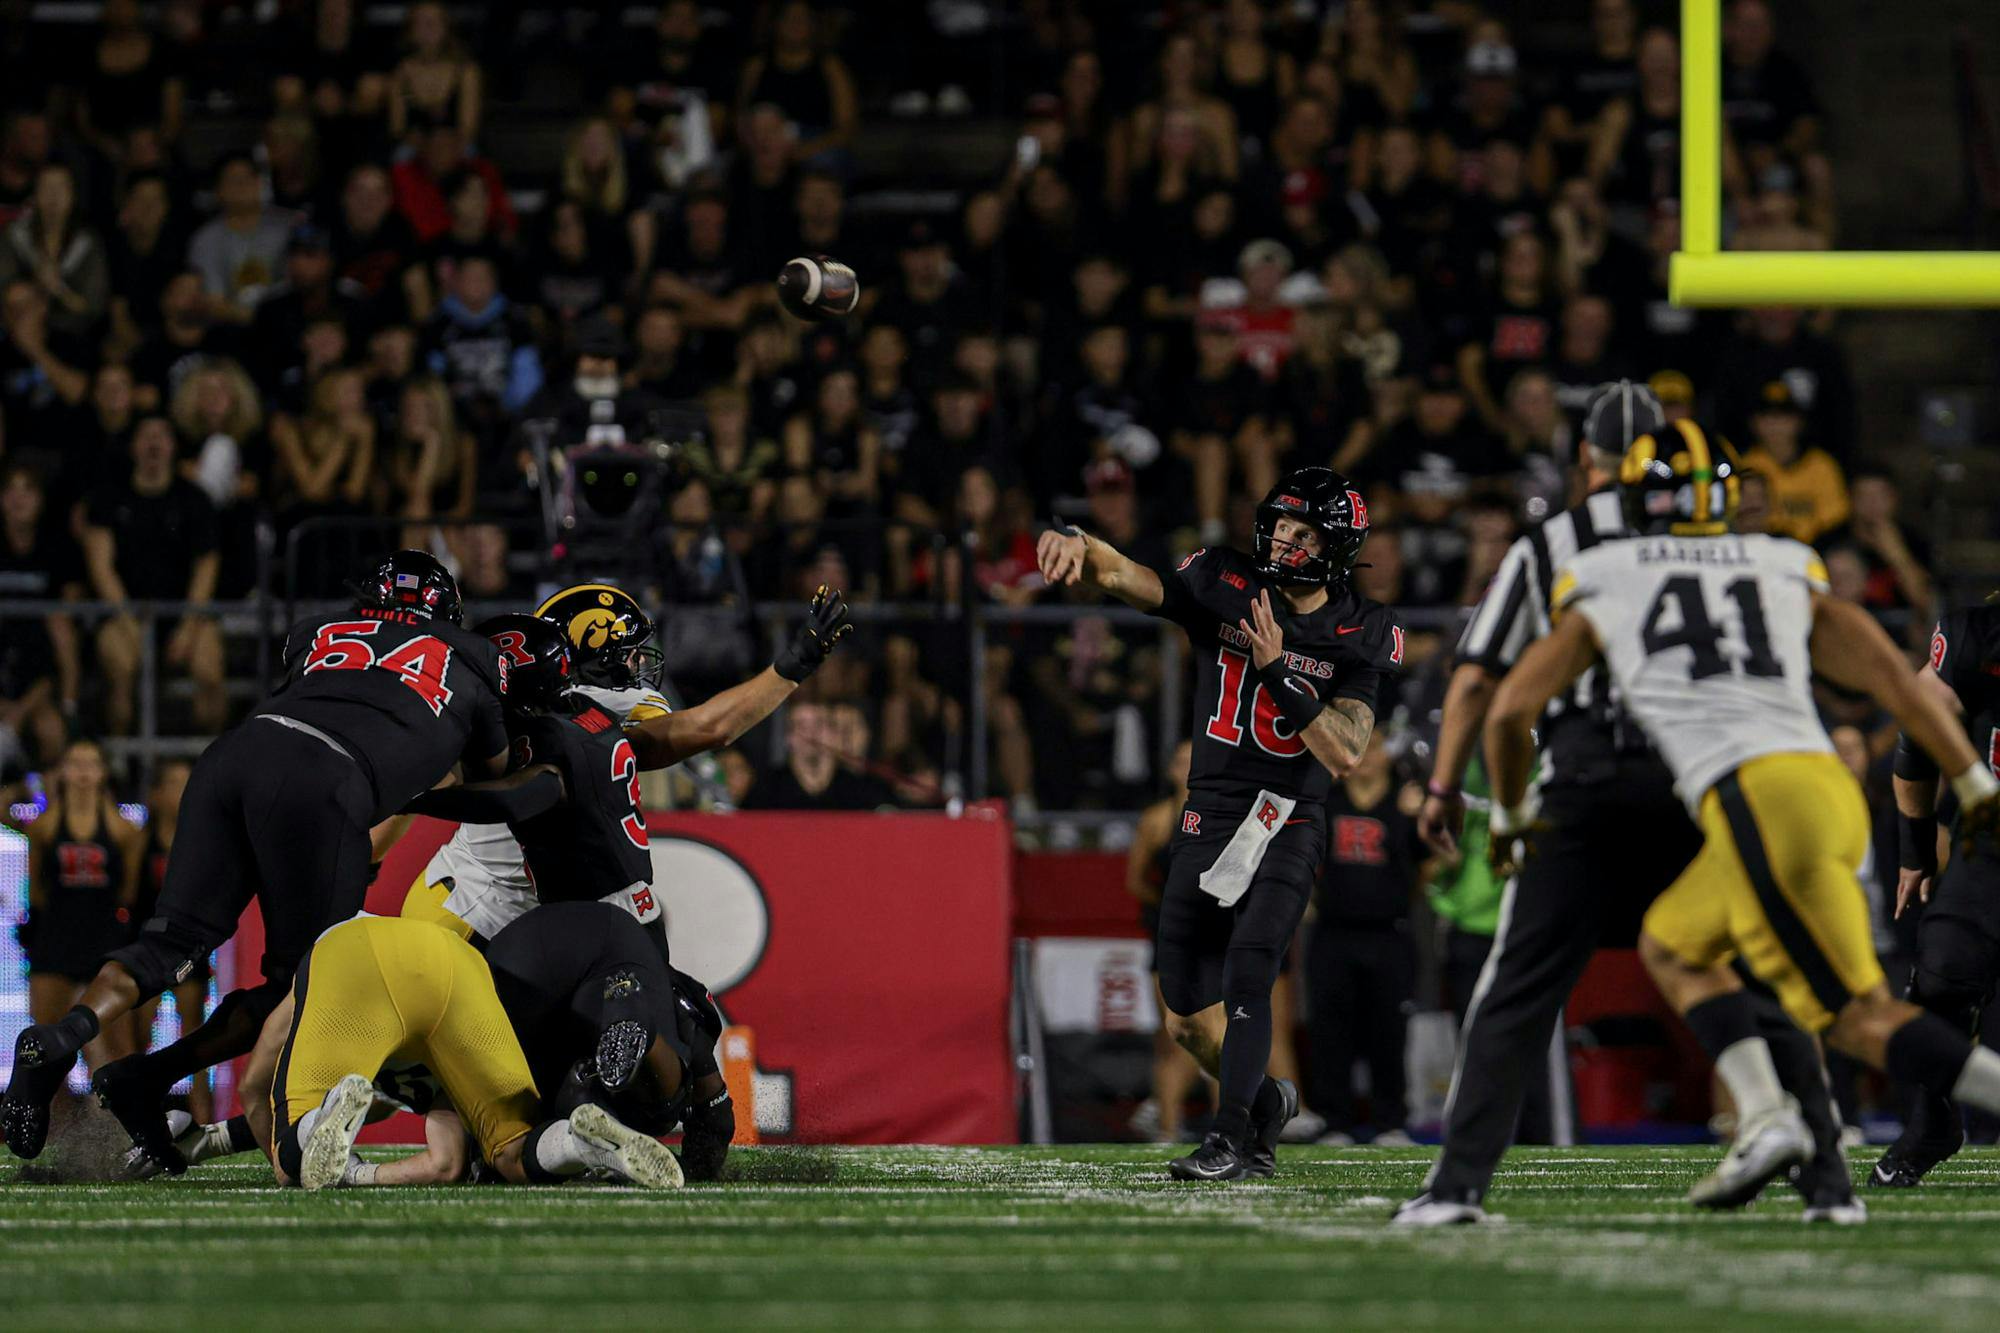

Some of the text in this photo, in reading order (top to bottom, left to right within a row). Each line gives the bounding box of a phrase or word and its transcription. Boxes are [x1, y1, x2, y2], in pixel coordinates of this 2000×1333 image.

[1345, 489, 1370, 529] R
[1643, 573, 1786, 680] 41
[488, 630, 536, 667] R
[303, 619, 453, 718] 54
[1181, 809, 1202, 835] R
[1256, 800, 1279, 831] R
[631, 886, 655, 917] R
